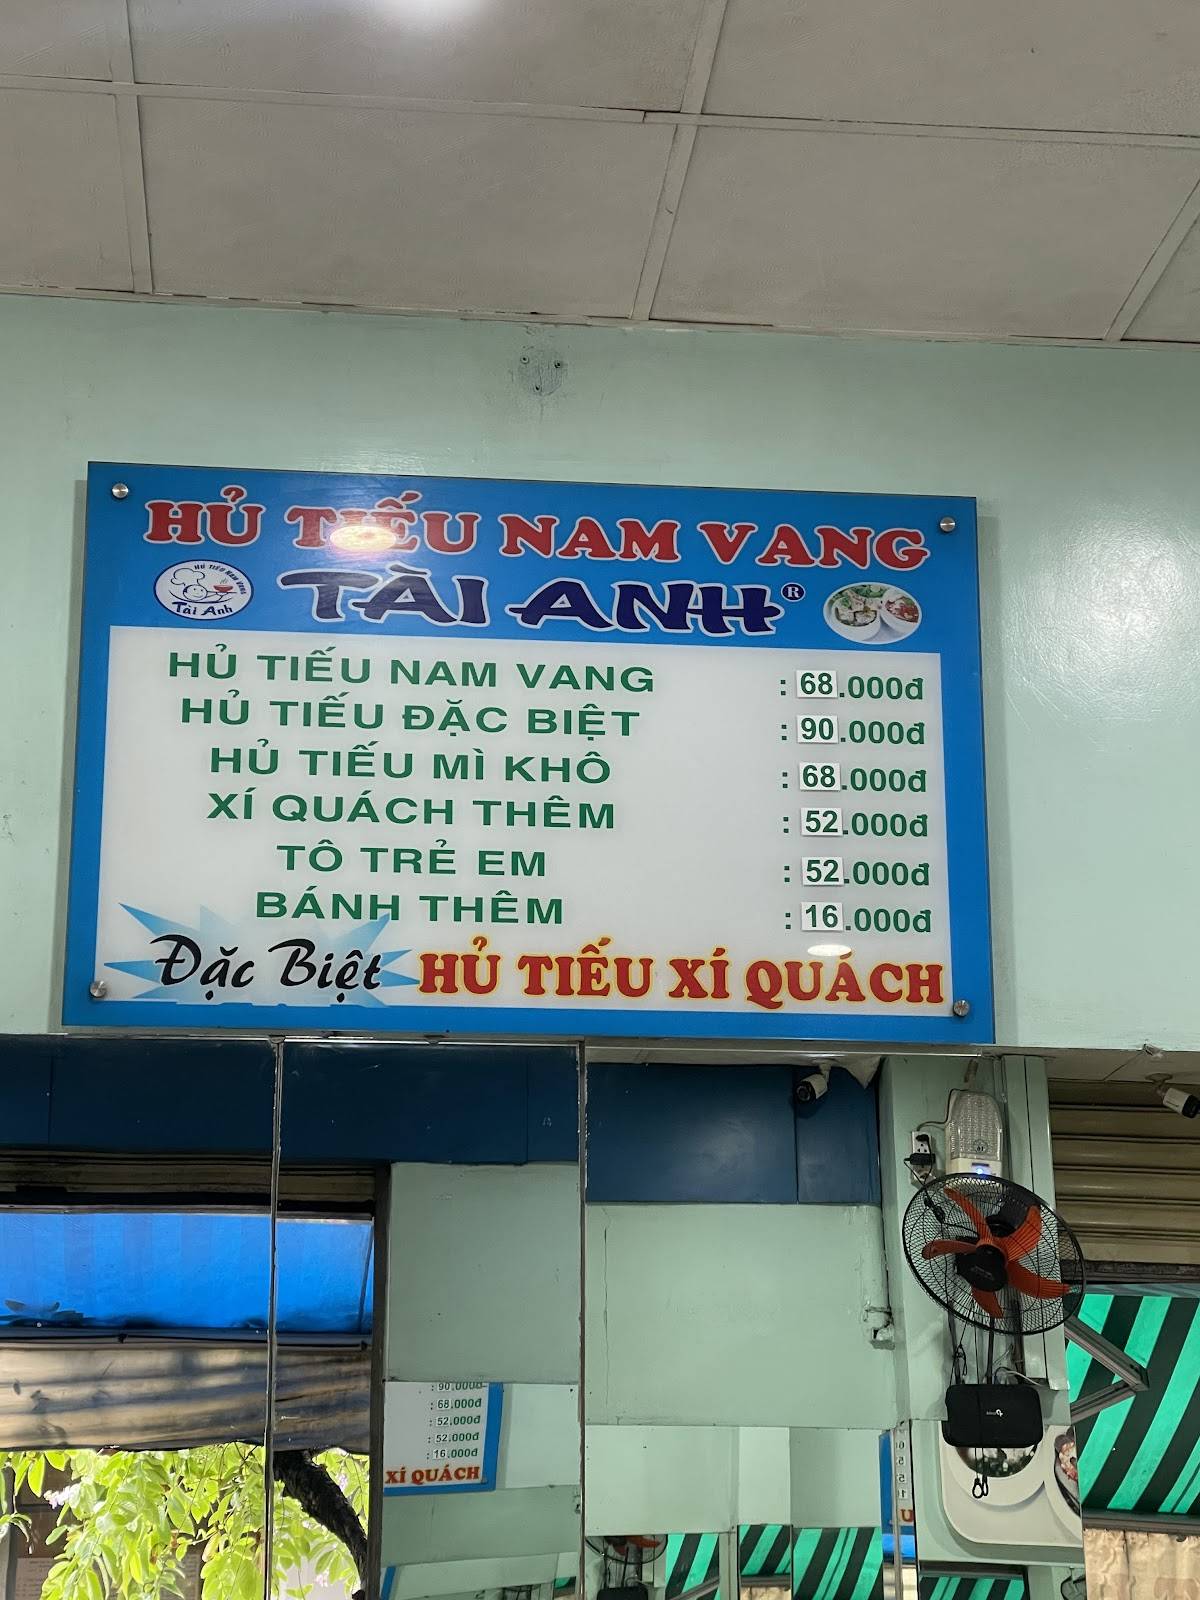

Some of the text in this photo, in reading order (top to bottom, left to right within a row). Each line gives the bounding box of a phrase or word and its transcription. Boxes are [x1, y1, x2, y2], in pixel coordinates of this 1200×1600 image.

[145, 486, 930, 570] HỦ TIẾU NAM VANG
[172, 601, 233, 616] Tài Anh
[278, 566, 488, 626] TÀI
[170, 644, 236, 679] HỦ
[257, 647, 370, 683] TIẾU
[391, 660, 496, 687] NAM
[516, 664, 653, 692] VANG
[801, 673, 923, 700] 68.000đ
[182, 690, 248, 725] HỦ
[270, 692, 383, 729] TIẾU
[402, 700, 507, 736] ĐẶC
[528, 704, 639, 741] BIỆT
[801, 718, 924, 744] 90.000đ
[211, 739, 278, 774] HỦ
[299, 741, 412, 778] TIẾU
[434, 748, 483, 780] MÌ
[506, 752, 610, 783] KHÔ
[803, 765, 926, 792] 68.000đ
[207, 787, 252, 820] XÍ
[273, 790, 452, 824] QUÁCH
[473, 795, 613, 828] THÊM
[806, 811, 927, 837] 52.000đ
[277, 840, 342, 871] TÔ
[360, 839, 455, 874] TRẺ
[479, 851, 544, 876] EM
[807, 860, 929, 887] 52.000đ
[257, 886, 399, 920] BÁNH
[419, 890, 562, 924] THÊM
[806, 905, 931, 932] 16.000đ
[150, 934, 944, 1009] Đặc Biệt HỦ TIẾU XÍ QUÁCH
[385, 1463, 480, 1485] XÍ QUÁCH
